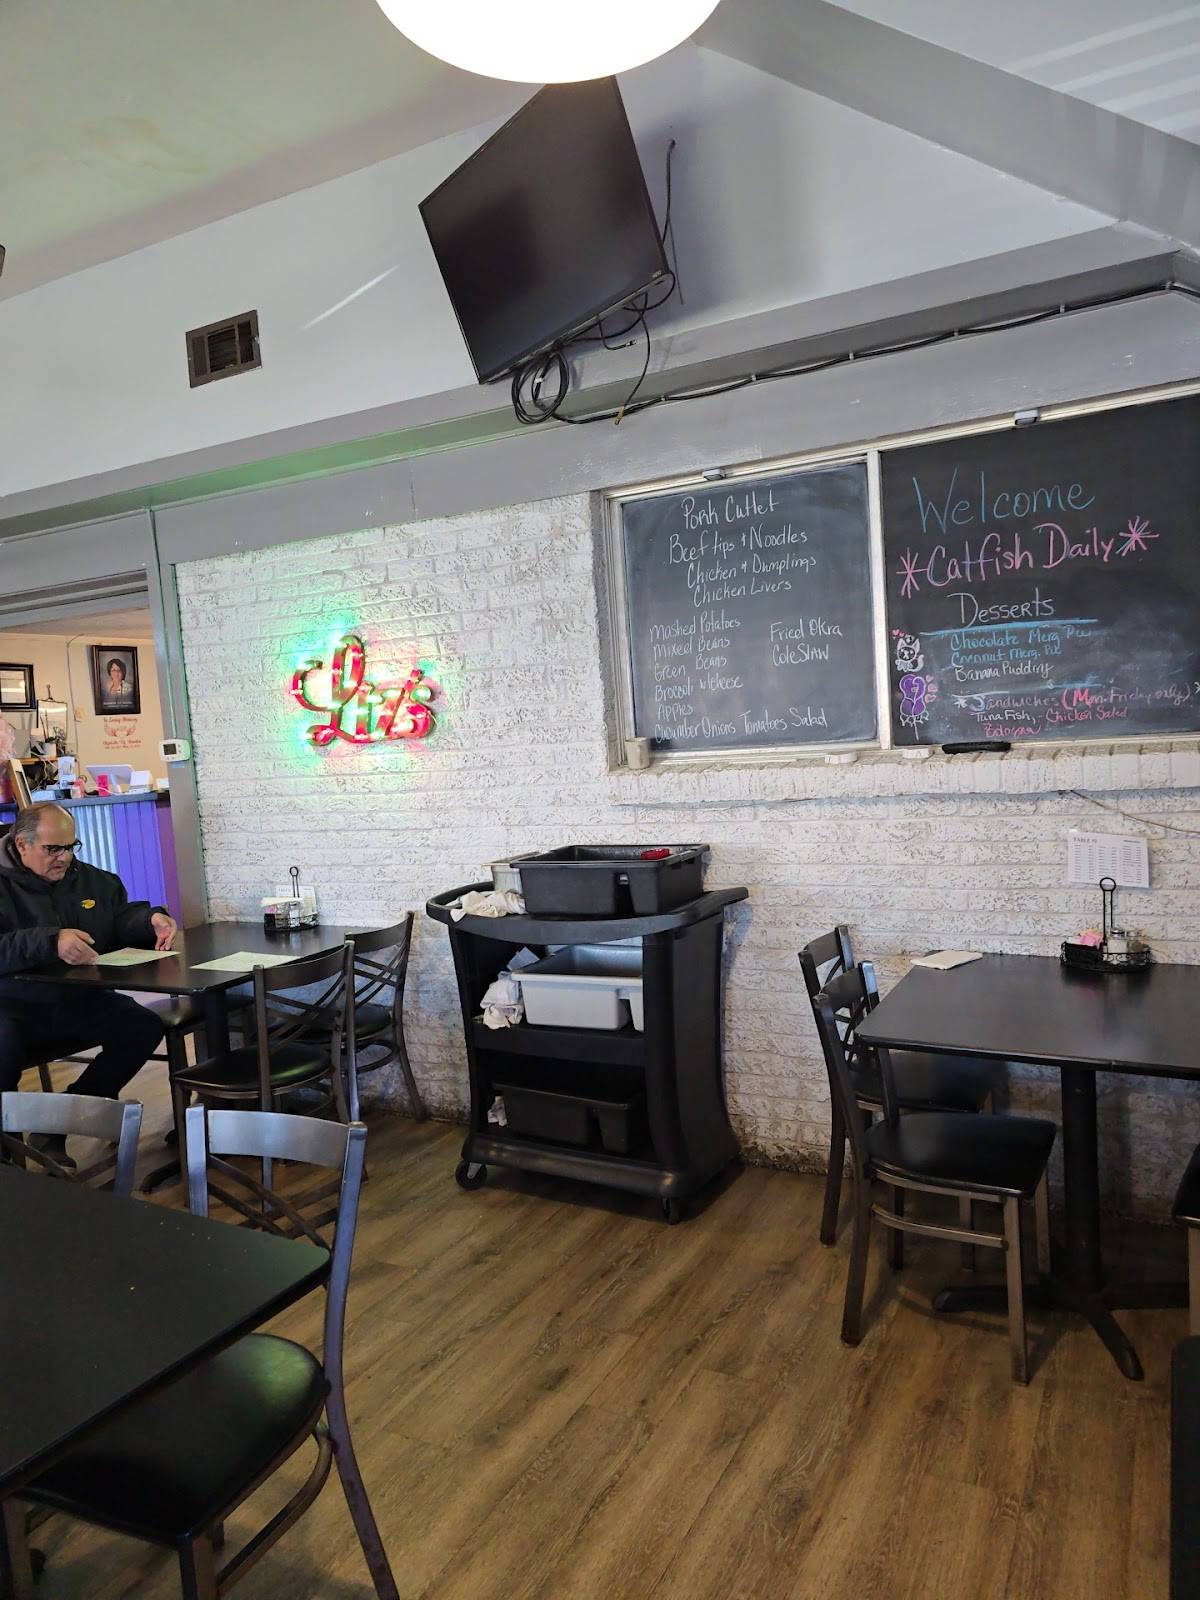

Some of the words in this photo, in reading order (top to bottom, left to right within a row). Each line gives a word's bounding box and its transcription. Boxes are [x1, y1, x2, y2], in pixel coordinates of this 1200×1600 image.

[681, 496, 718, 530] Pork
[726, 490, 779, 523] Cutlet
[913, 468, 1095, 534] Welcome
[669, 530, 708, 565] Beef
[750, 523, 808, 551] Noodles
[927, 532, 1034, 587] Catfish
[1033, 523, 1114, 569] Daily
[687, 560, 737, 589] Chicken
[752, 553, 817, 576] Dumplings
[693, 582, 746, 608] Chicken
[750, 577, 792, 596] Livers
[699, 609, 741, 634] Potatoes
[947, 587, 1055, 628] Desserts
[697, 635, 730, 652] Beans
[770, 618, 804, 642] Fried
[950, 630, 1020, 651] Chocolate
[655, 664, 686, 682] Green
[695, 653, 727, 671] Beans
[955, 666, 1001, 682] Banana
[1002, 660, 1055, 679] Pudding
[655, 676, 694, 702] Broccoli
[657, 703, 694, 722] Apples
[701, 716, 736, 738] Onions
[738, 709, 787, 736] Tomatoes
[789, 706, 828, 728] Salad
[970, 711, 1003, 723] Tuna
[1045, 707, 1092, 723] Chicken
[1096, 705, 1128, 721] Salad
